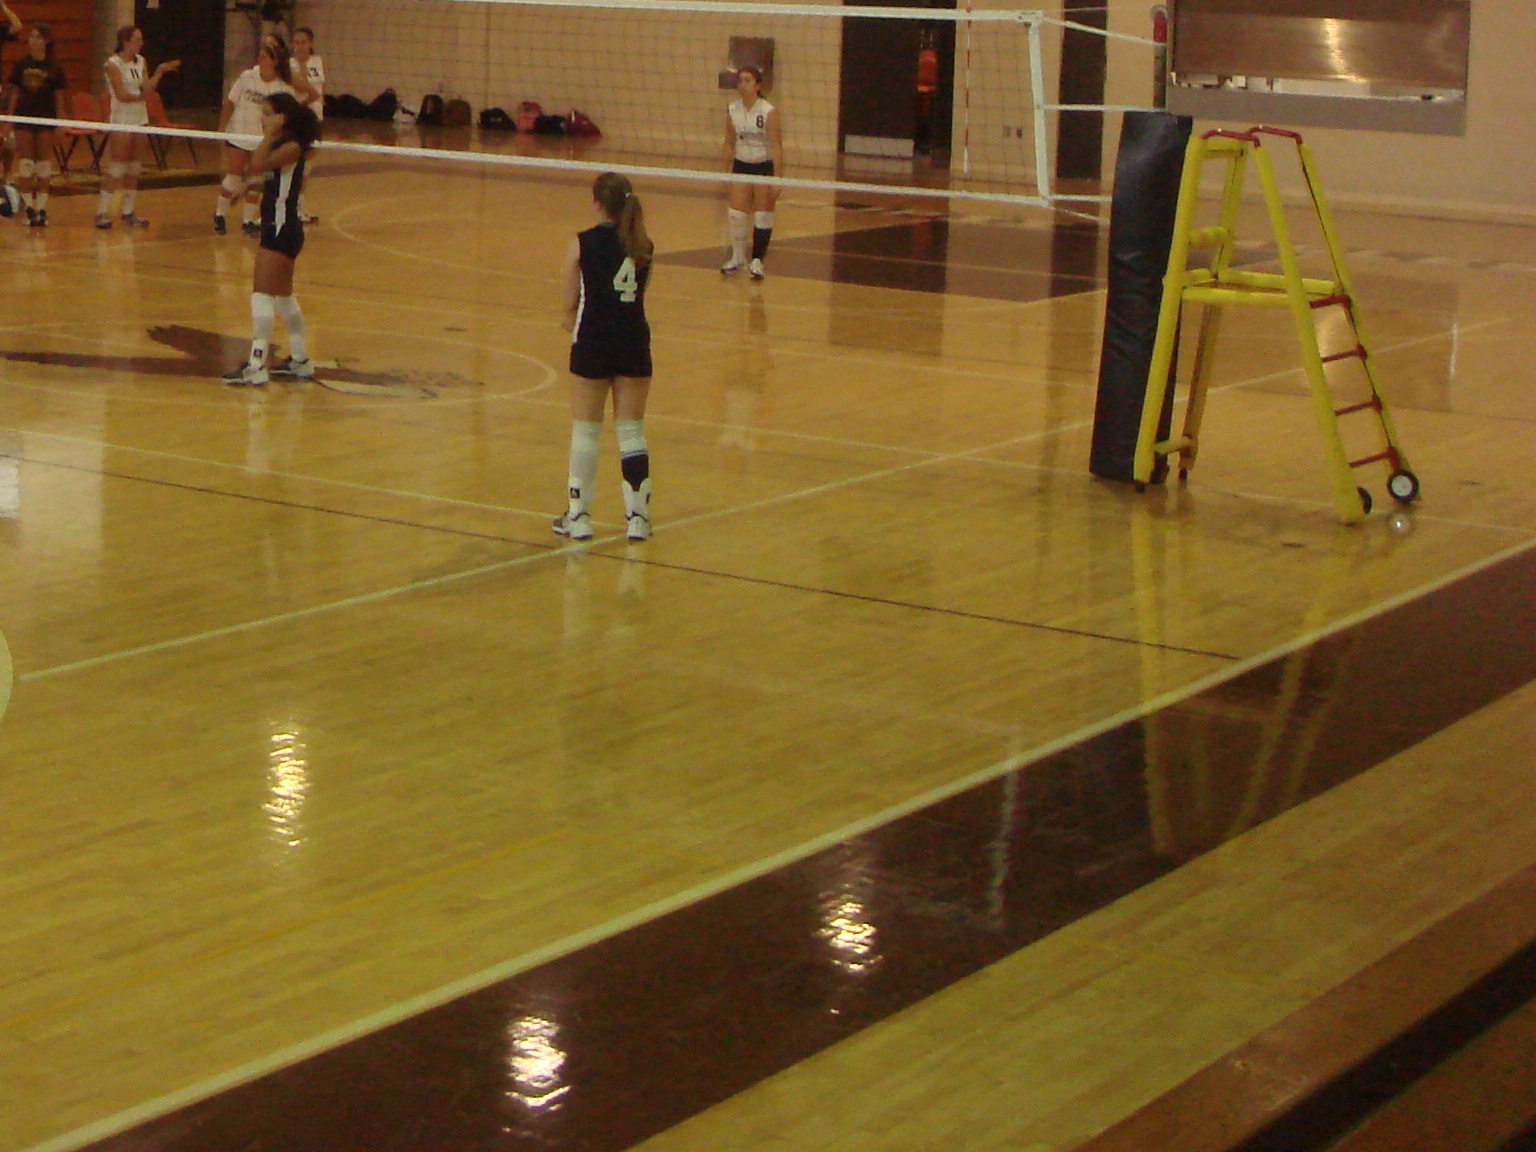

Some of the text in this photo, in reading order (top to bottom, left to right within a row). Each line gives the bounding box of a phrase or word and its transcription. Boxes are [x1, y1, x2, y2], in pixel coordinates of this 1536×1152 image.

[130, 68, 139, 79] 11
[756, 115, 764, 128] 8
[613, 256, 638, 303] 4
